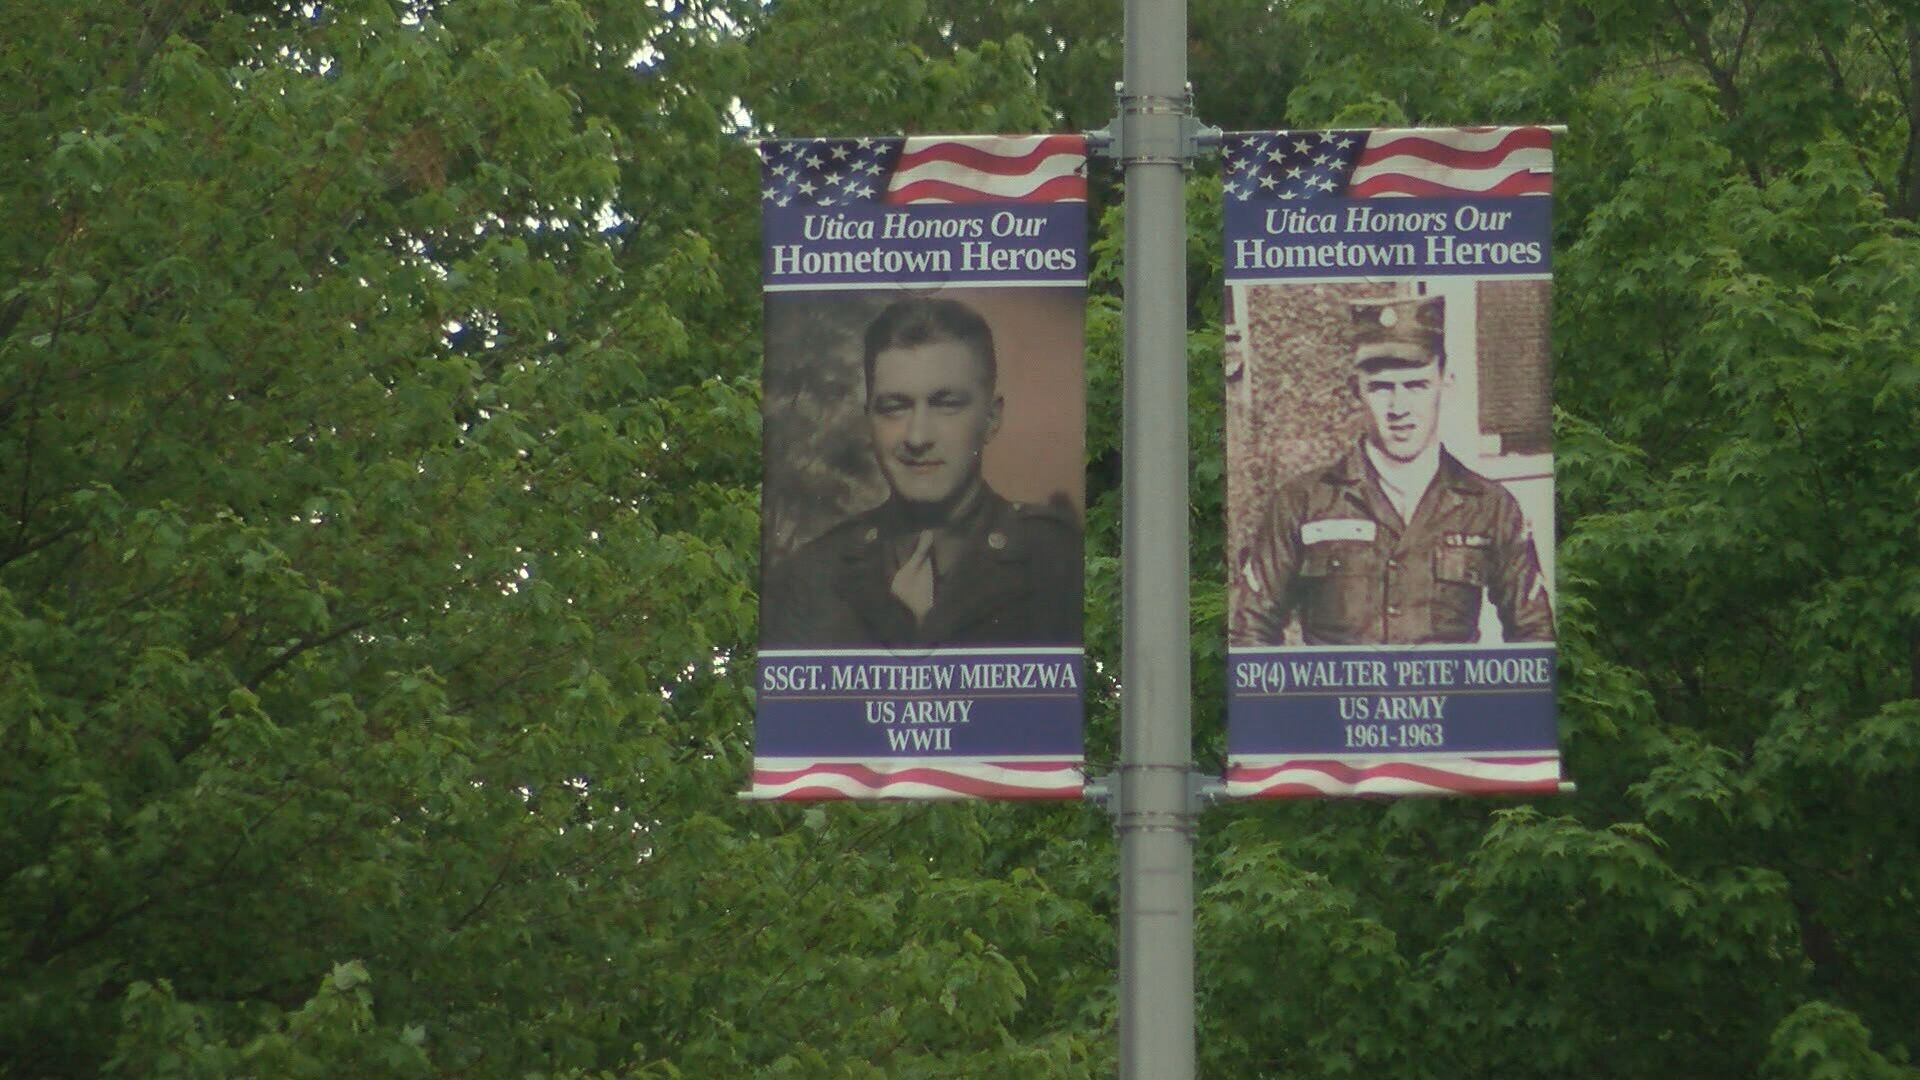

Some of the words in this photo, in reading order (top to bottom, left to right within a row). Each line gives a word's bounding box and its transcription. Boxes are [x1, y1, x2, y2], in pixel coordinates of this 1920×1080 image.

[804, 213, 874, 240] Utica
[882, 213, 983, 239] Honors
[990, 211, 1047, 238] Our
[1265, 207, 1336, 235] Utica
[1344, 206, 1447, 233] Honors
[1454, 205, 1512, 231] Our
[772, 244, 951, 275] Hometown
[960, 241, 1076, 271] Heroes
[1233, 239, 1415, 269] Hometown
[1424, 235, 1542, 265] Heroes
[763, 665, 826, 692] SSGT.
[831, 664, 955, 691] MATTHEW
[960, 663, 1077, 689] MIERZWA
[1236, 662, 1286, 693] SP(4)
[1291, 660, 1388, 687] WALTER
[1464, 658, 1549, 685] MOORE
[865, 701, 896, 724] US
[900, 700, 974, 724] ARMY
[1338, 697, 1368, 720] US
[1374, 695, 1448, 719] ARMY
[887, 728, 951, 751] WWII
[1344, 724, 1443, 748] 1961-1963
